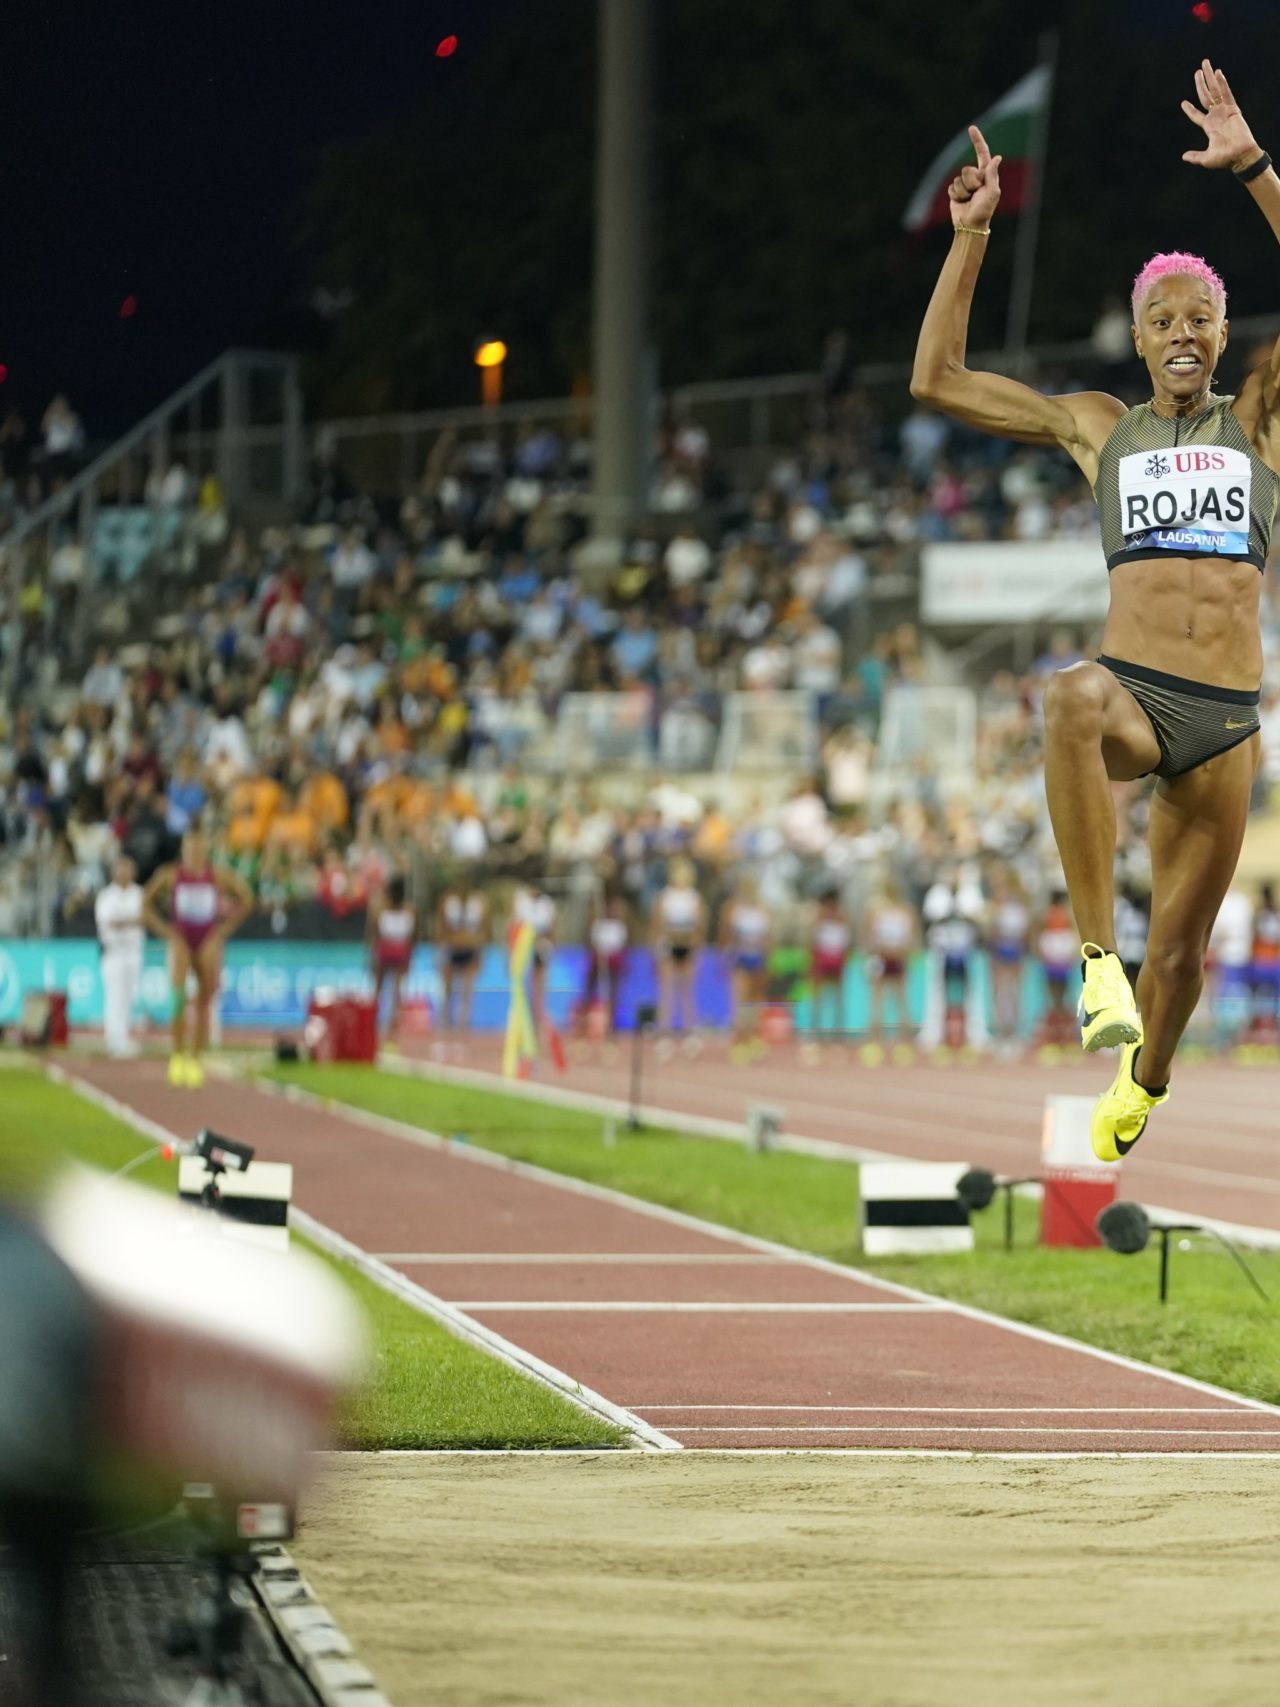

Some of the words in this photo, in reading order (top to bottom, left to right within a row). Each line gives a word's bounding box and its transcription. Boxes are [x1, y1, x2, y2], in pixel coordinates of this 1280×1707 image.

[1174, 451, 1226, 473] UBS
[1126, 486, 1245, 529] ROJAS
[1158, 530, 1227, 547] LAUSANNE
